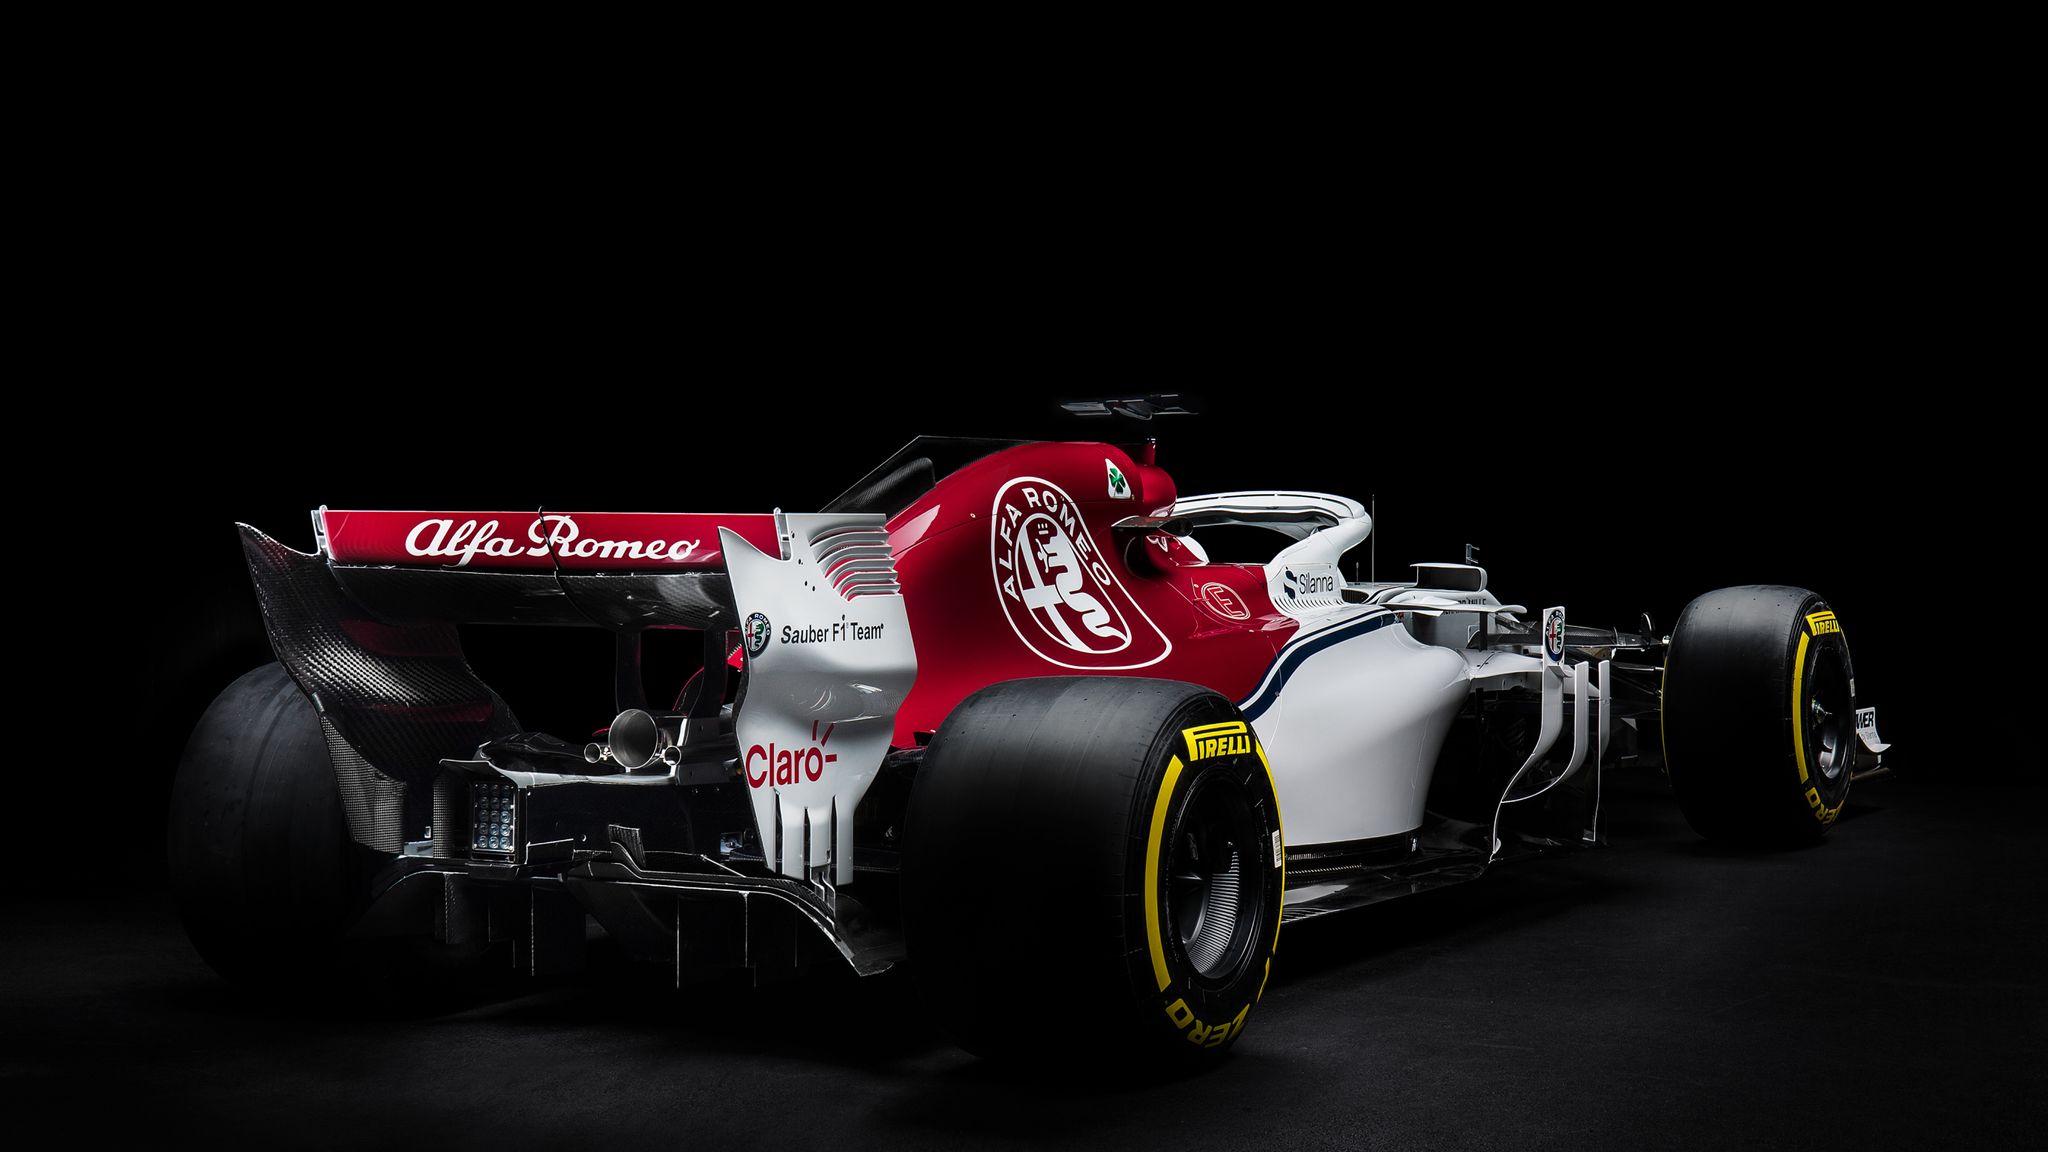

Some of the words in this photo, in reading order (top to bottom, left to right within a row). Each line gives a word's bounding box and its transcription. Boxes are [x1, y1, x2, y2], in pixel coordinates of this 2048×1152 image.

[405, 519, 525, 568] Alfa
[528, 515, 700, 560] Romeo
[1000, 503, 1022, 602] ALFA
[1022, 487, 1111, 586] ROMEO
[1299, 573, 1334, 595] Silanna
[781, 624, 829, 644] Sauber
[832, 623, 846, 641] F1
[850, 622, 882, 640] Team
[1805, 610, 1840, 636] PIRELLI
[1855, 711, 1875, 729] WER
[1182, 721, 1250, 761] PIRELLI
[745, 742, 824, 789] Claro
[1165, 998, 1250, 1048] ZERO
